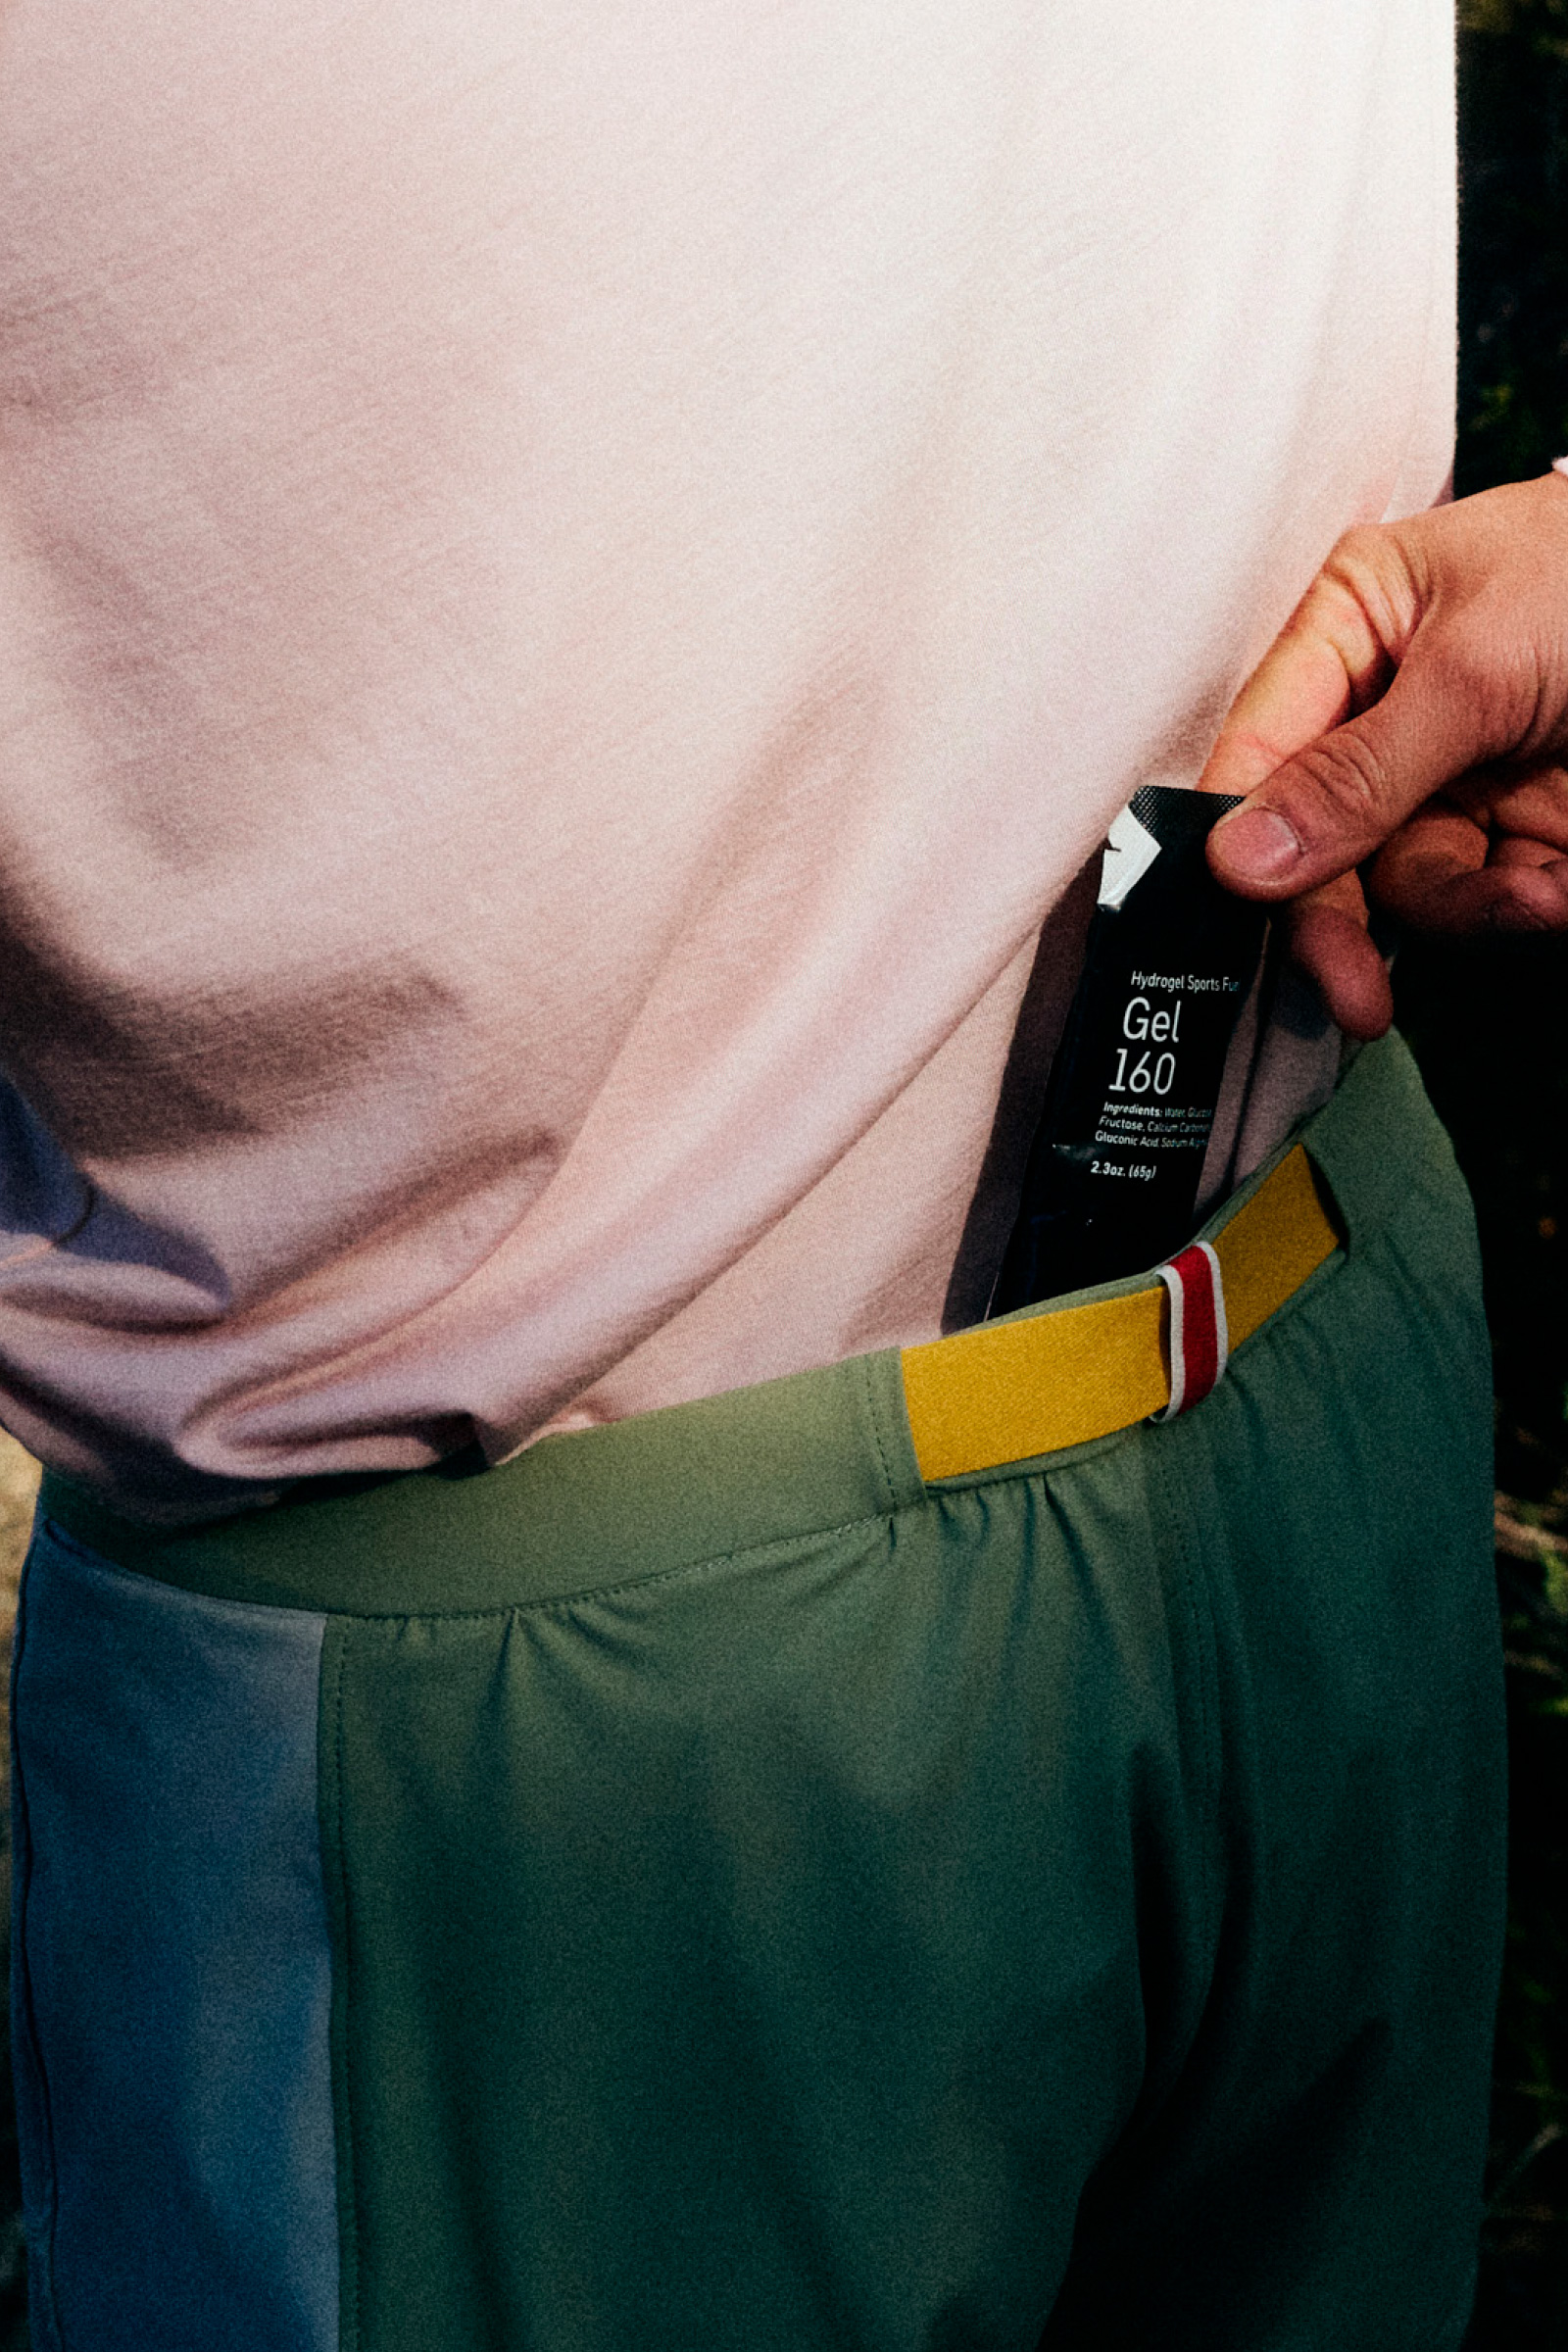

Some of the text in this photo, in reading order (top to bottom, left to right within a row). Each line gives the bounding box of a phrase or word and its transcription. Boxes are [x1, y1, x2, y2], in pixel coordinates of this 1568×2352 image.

[1130, 969, 1241, 994] Hydrogel Sports Fue
[1122, 996, 1181, 1043] Gel
[1107, 1048, 1176, 1095] 160
[1102, 1102, 1163, 1117] Ingredients:
[1095, 1130, 1139, 1146] Gluconic
[1090, 1160, 1157, 1182] 2.3oz. (65g)
